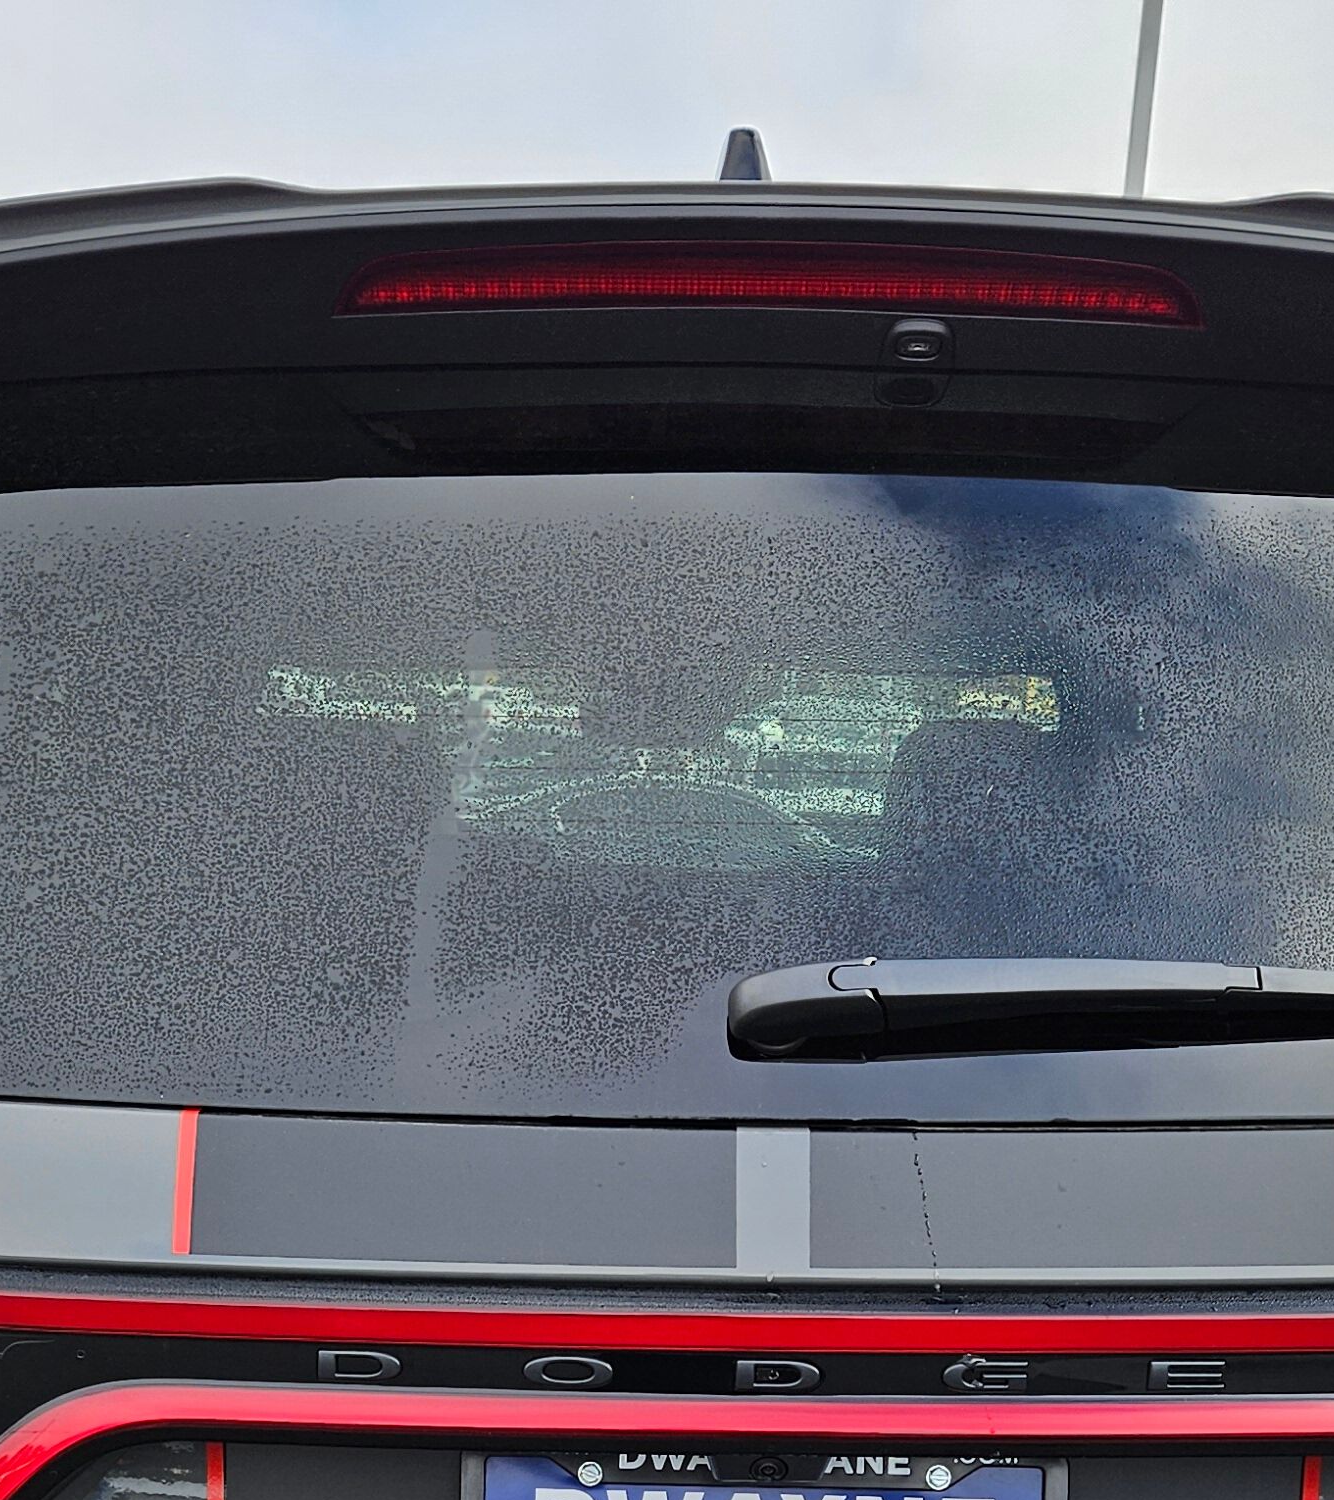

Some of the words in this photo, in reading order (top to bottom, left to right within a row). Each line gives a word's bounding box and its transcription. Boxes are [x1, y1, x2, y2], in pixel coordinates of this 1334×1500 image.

[317, 1349, 1226, 1392] DODGE
[619, 1453, 712, 1471] DWA
[824, 1456, 911, 1476] ANE
